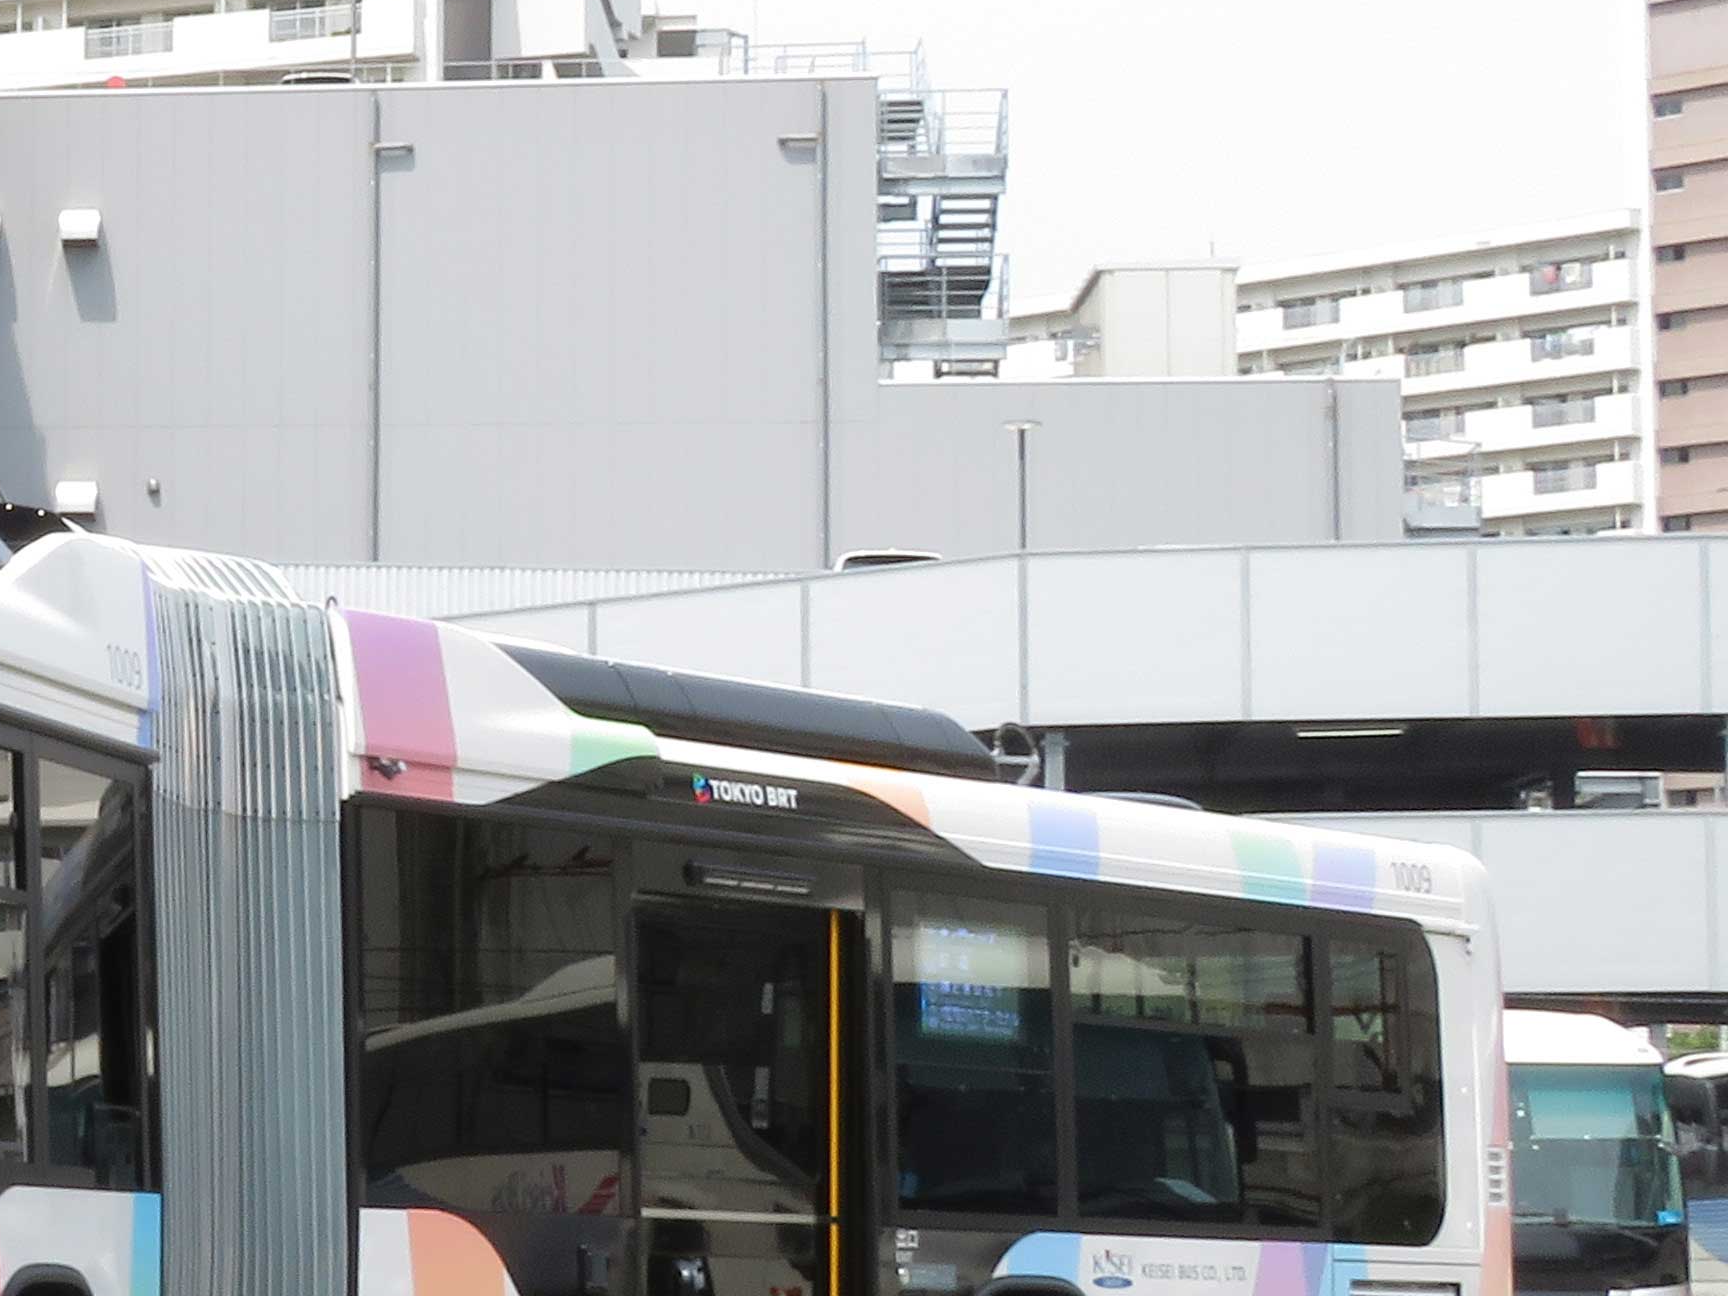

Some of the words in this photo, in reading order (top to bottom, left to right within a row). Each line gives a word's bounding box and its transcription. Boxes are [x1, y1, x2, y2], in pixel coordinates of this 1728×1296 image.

[707, 778, 765, 806] TOKYO
[765, 785, 798, 810] BRT
[1390, 861, 1433, 894] 1009
[1141, 1263, 1176, 1279] KEISEI
[1178, 1263, 1199, 1280] BUS
